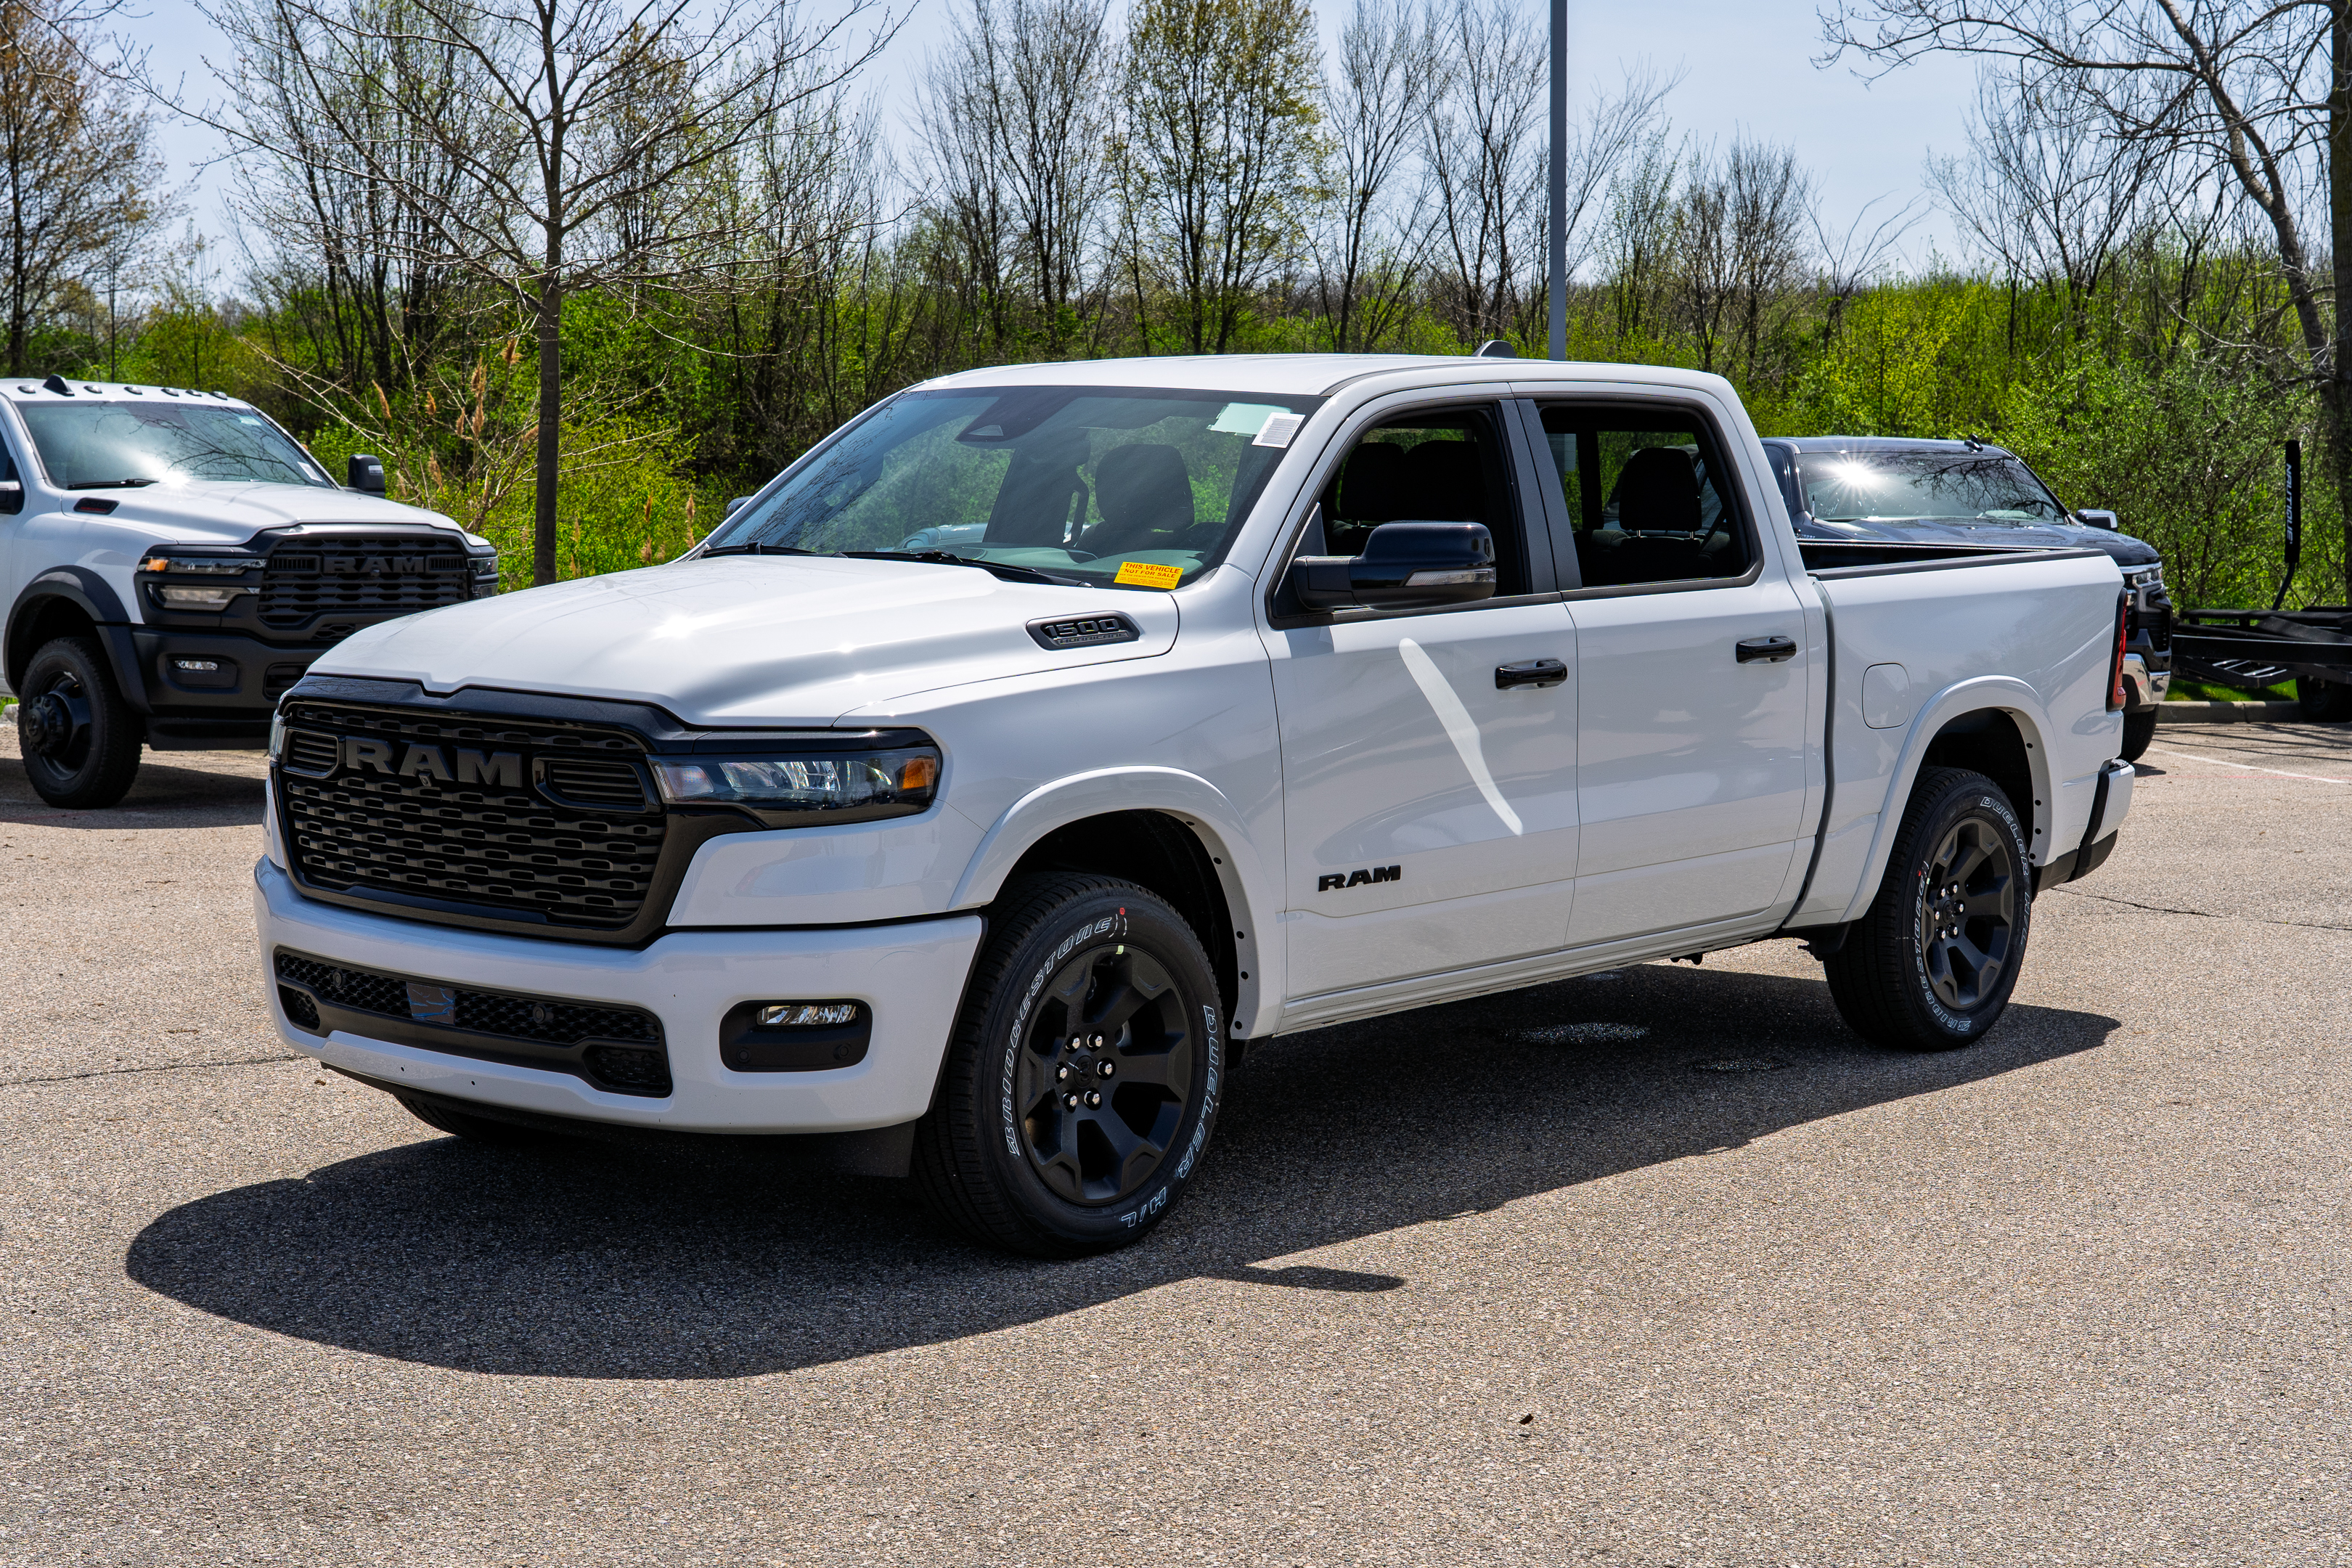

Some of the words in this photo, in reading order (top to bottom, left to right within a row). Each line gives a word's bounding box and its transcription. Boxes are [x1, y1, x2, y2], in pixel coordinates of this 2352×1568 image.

[323, 556, 425, 573] RAM
[1146, 565, 1180, 573] VEHICLE
[1045, 618, 1120, 637] 1500
[1060, 633, 1126, 644] HURRICANE
[344, 735, 523, 788] RAM
[1980, 796, 2030, 876] DUELER
[1318, 865, 1401, 892] RAM
[1914, 874, 1972, 1032] BRIDGESTONE
[1000, 916, 1112, 1156] BRIDGESTONE
[1177, 1005, 1219, 1179] DUELER
[1120, 1185, 1167, 1228] H/L
